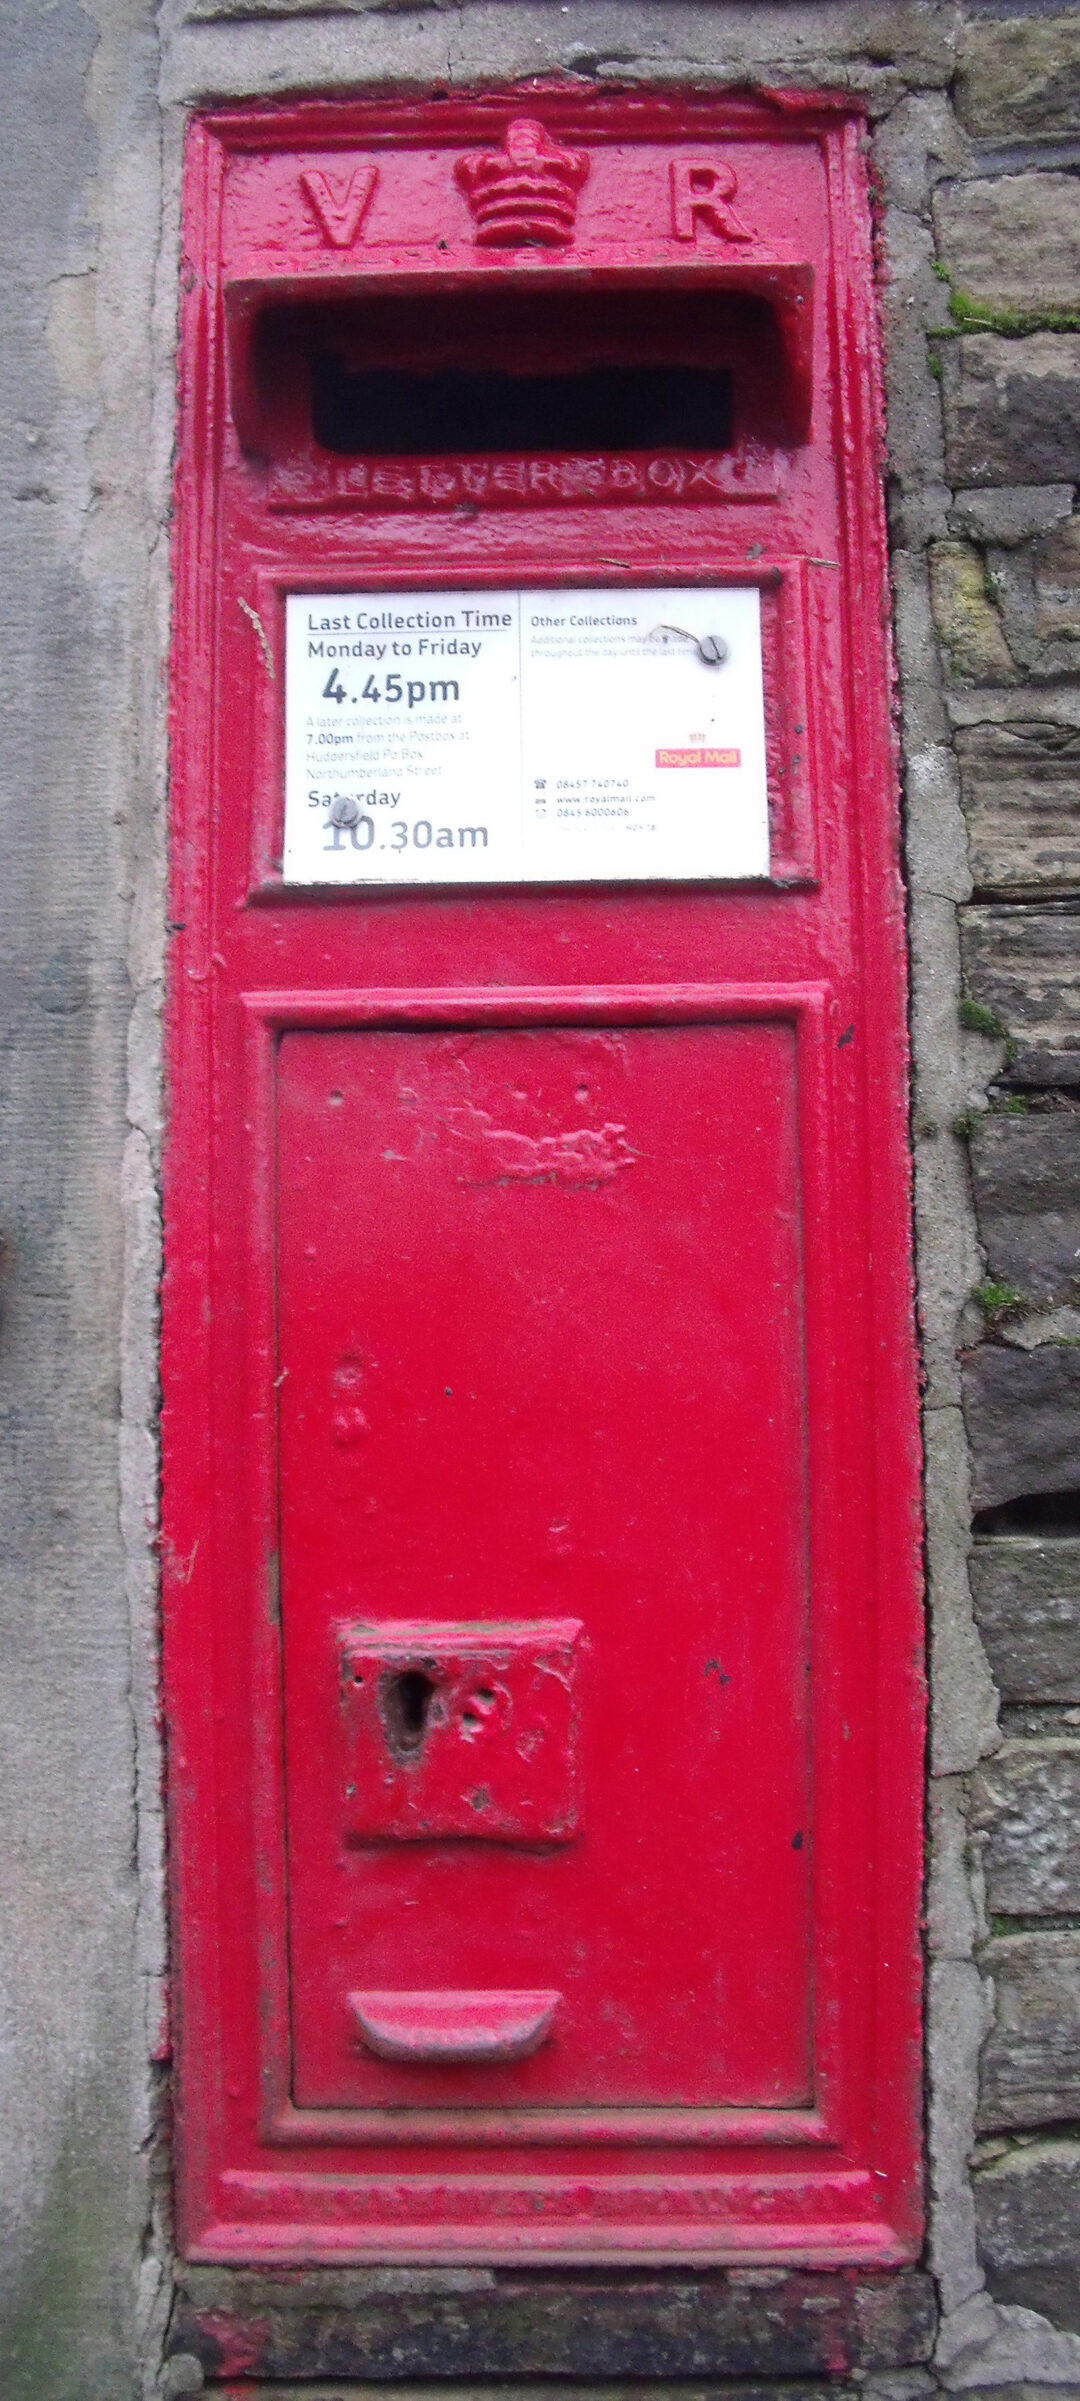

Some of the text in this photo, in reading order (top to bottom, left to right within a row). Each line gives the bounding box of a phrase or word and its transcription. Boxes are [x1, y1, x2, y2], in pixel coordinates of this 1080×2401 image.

[299, 157, 755, 250] V R
[335, 458, 723, 498] LETTER BOX
[307, 610, 513, 631] Last Collection Time
[531, 614, 638, 627] Other Collections
[307, 638, 482, 661] Monday to Friday
[322, 667, 460, 709] 4.45pm
[306, 713, 462, 728] A later collection is made at
[306, 733, 354, 746] 7.00pm
[356, 731, 385, 744] from
[387, 731, 406, 743] the
[658, 750, 738, 767] Royal Mail
[556, 779, 629, 789] 08457 740740
[307, 789, 401, 809] Sarday
[322, 815, 489, 851] 10.30am
